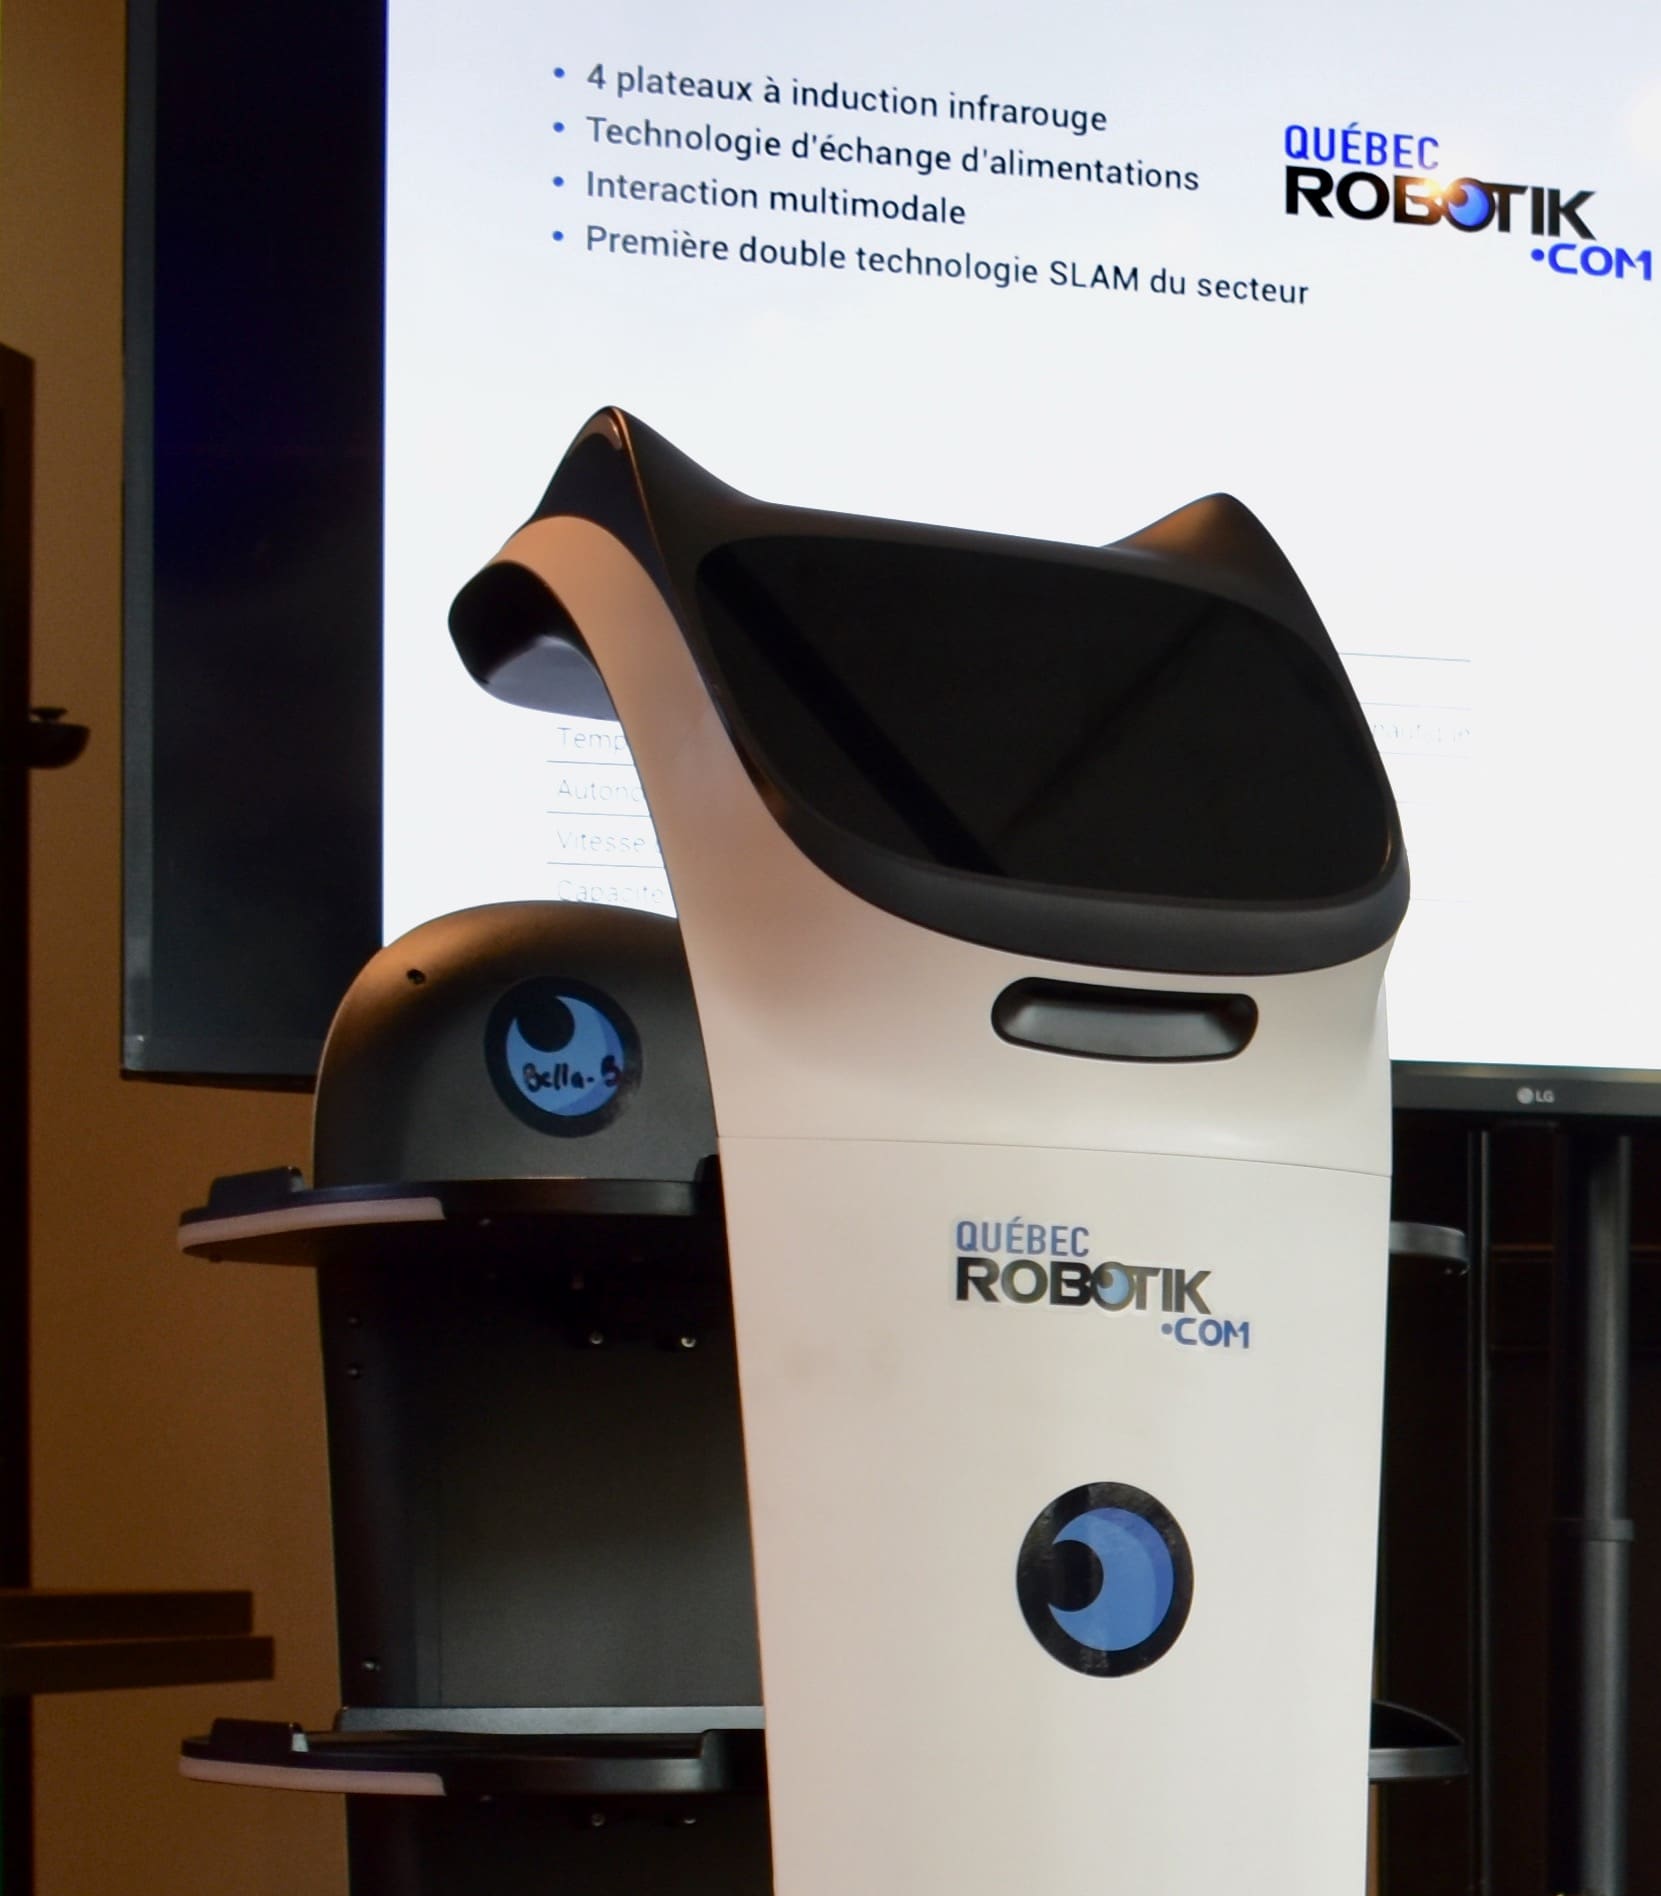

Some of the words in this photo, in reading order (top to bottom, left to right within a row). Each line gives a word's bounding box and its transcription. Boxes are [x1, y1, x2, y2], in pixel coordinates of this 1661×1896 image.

[586, 62, 606, 90] 4
[617, 64, 752, 102] plateaux
[764, 75, 781, 104] à
[792, 78, 938, 117] induction
[949, 91, 1107, 136] infrarouge
[586, 115, 781, 161] Technologie
[792, 132, 952, 176] d'échange
[961, 146, 1200, 191] d'alimentations
[1285, 122, 1440, 170] QUÉBEC
[586, 171, 758, 210] Interaction
[769, 186, 966, 225] multimodale
[1285, 165, 1597, 241] ROBOTIK
[586, 225, 729, 261] Première
[739, 236, 846, 270] double
[856, 247, 1038, 288] technologie
[1049, 260, 1139, 293] SLAM
[1150, 268, 1186, 296] du
[1197, 276, 1309, 305] secteur
[557, 830, 646, 853] Vitesse
[1535, 1089, 1554, 1104] LG
[956, 1216, 1091, 1257] QUÉBEC
[956, 1256, 1213, 1315] ROBOTIK
